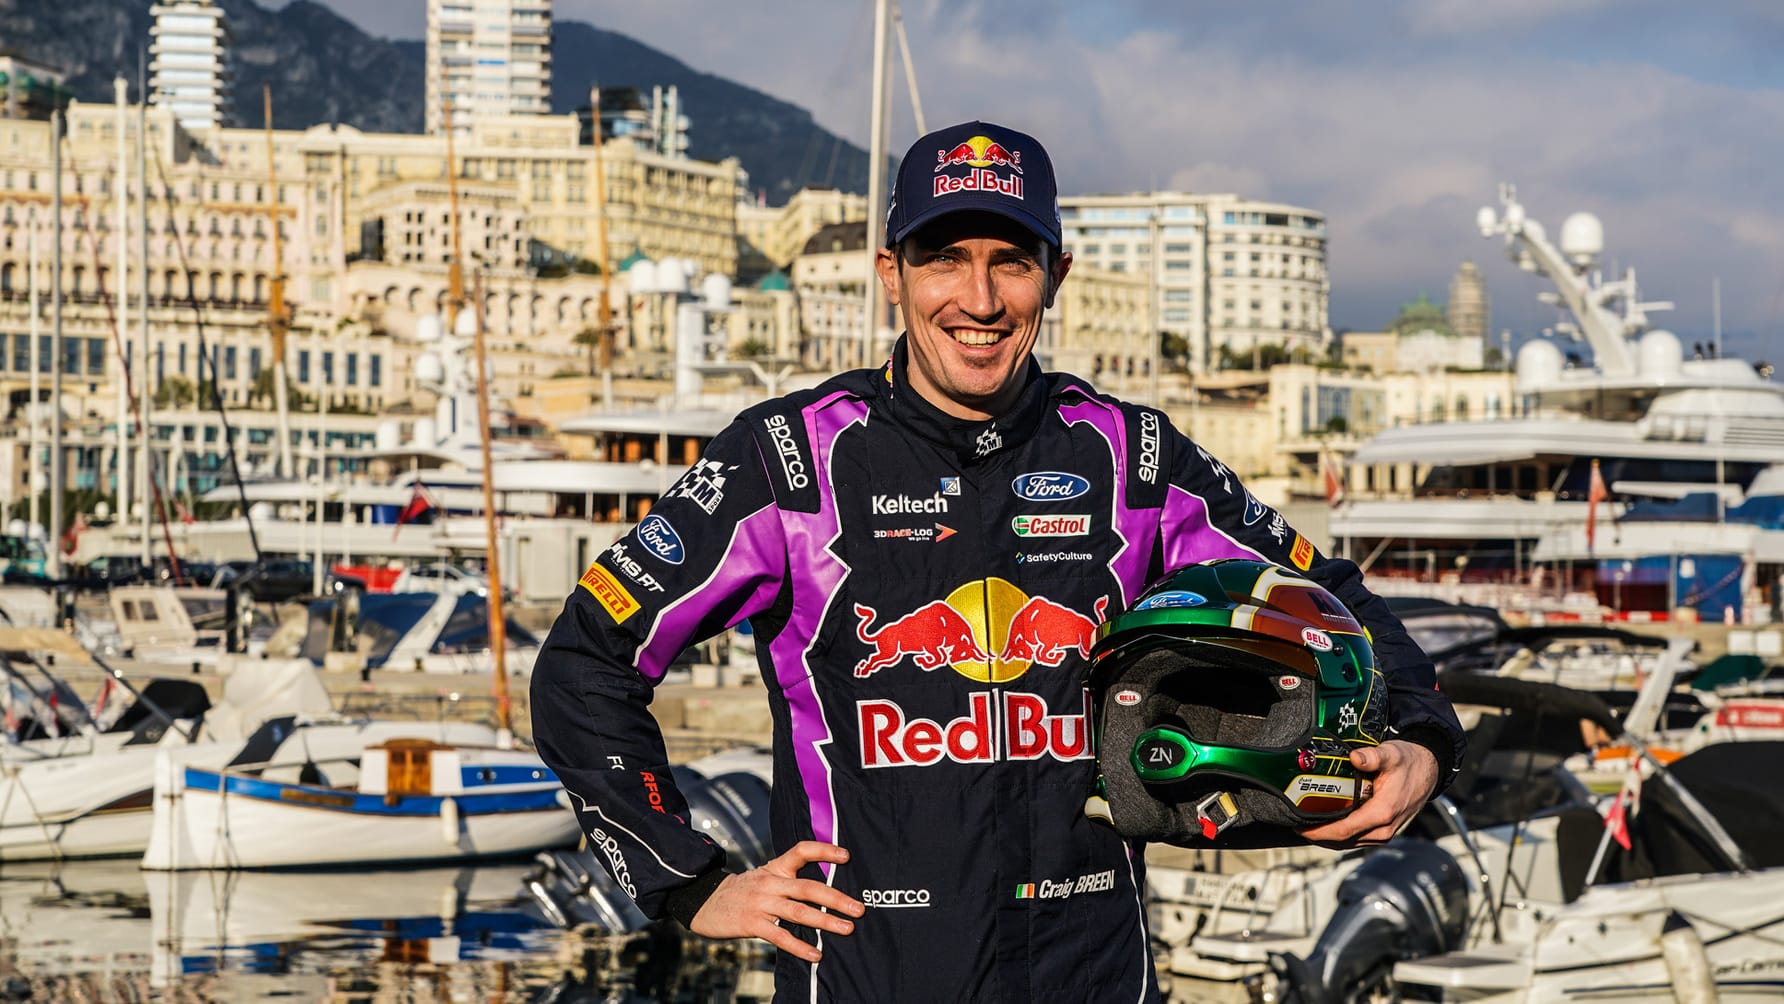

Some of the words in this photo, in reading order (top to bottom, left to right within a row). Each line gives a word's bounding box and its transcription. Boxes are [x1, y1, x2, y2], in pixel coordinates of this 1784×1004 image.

[933, 168, 979, 198] Red
[981, 169, 1024, 200] Bull
[765, 414, 808, 490] sparco
[1138, 412, 1159, 485] sparco
[691, 479, 718, 507] M
[1025, 475, 1074, 497] Ford
[872, 491, 948, 514] Keltech
[641, 518, 677, 556] Ford
[1030, 517, 1086, 534] Castrol
[1026, 551, 1093, 562] SafetyCulture
[582, 567, 631, 615] PIRELLI
[1306, 631, 1329, 647] BELL
[856, 691, 995, 769] Red
[1003, 690, 1096, 763] Bul
[1149, 747, 1173, 765] ZN
[1300, 783, 1342, 793] BREEN
[590, 827, 637, 903] sparco
[1039, 878, 1075, 899] Craig
[1073, 869, 1115, 895] BREEN
[862, 889, 930, 908] sparco
